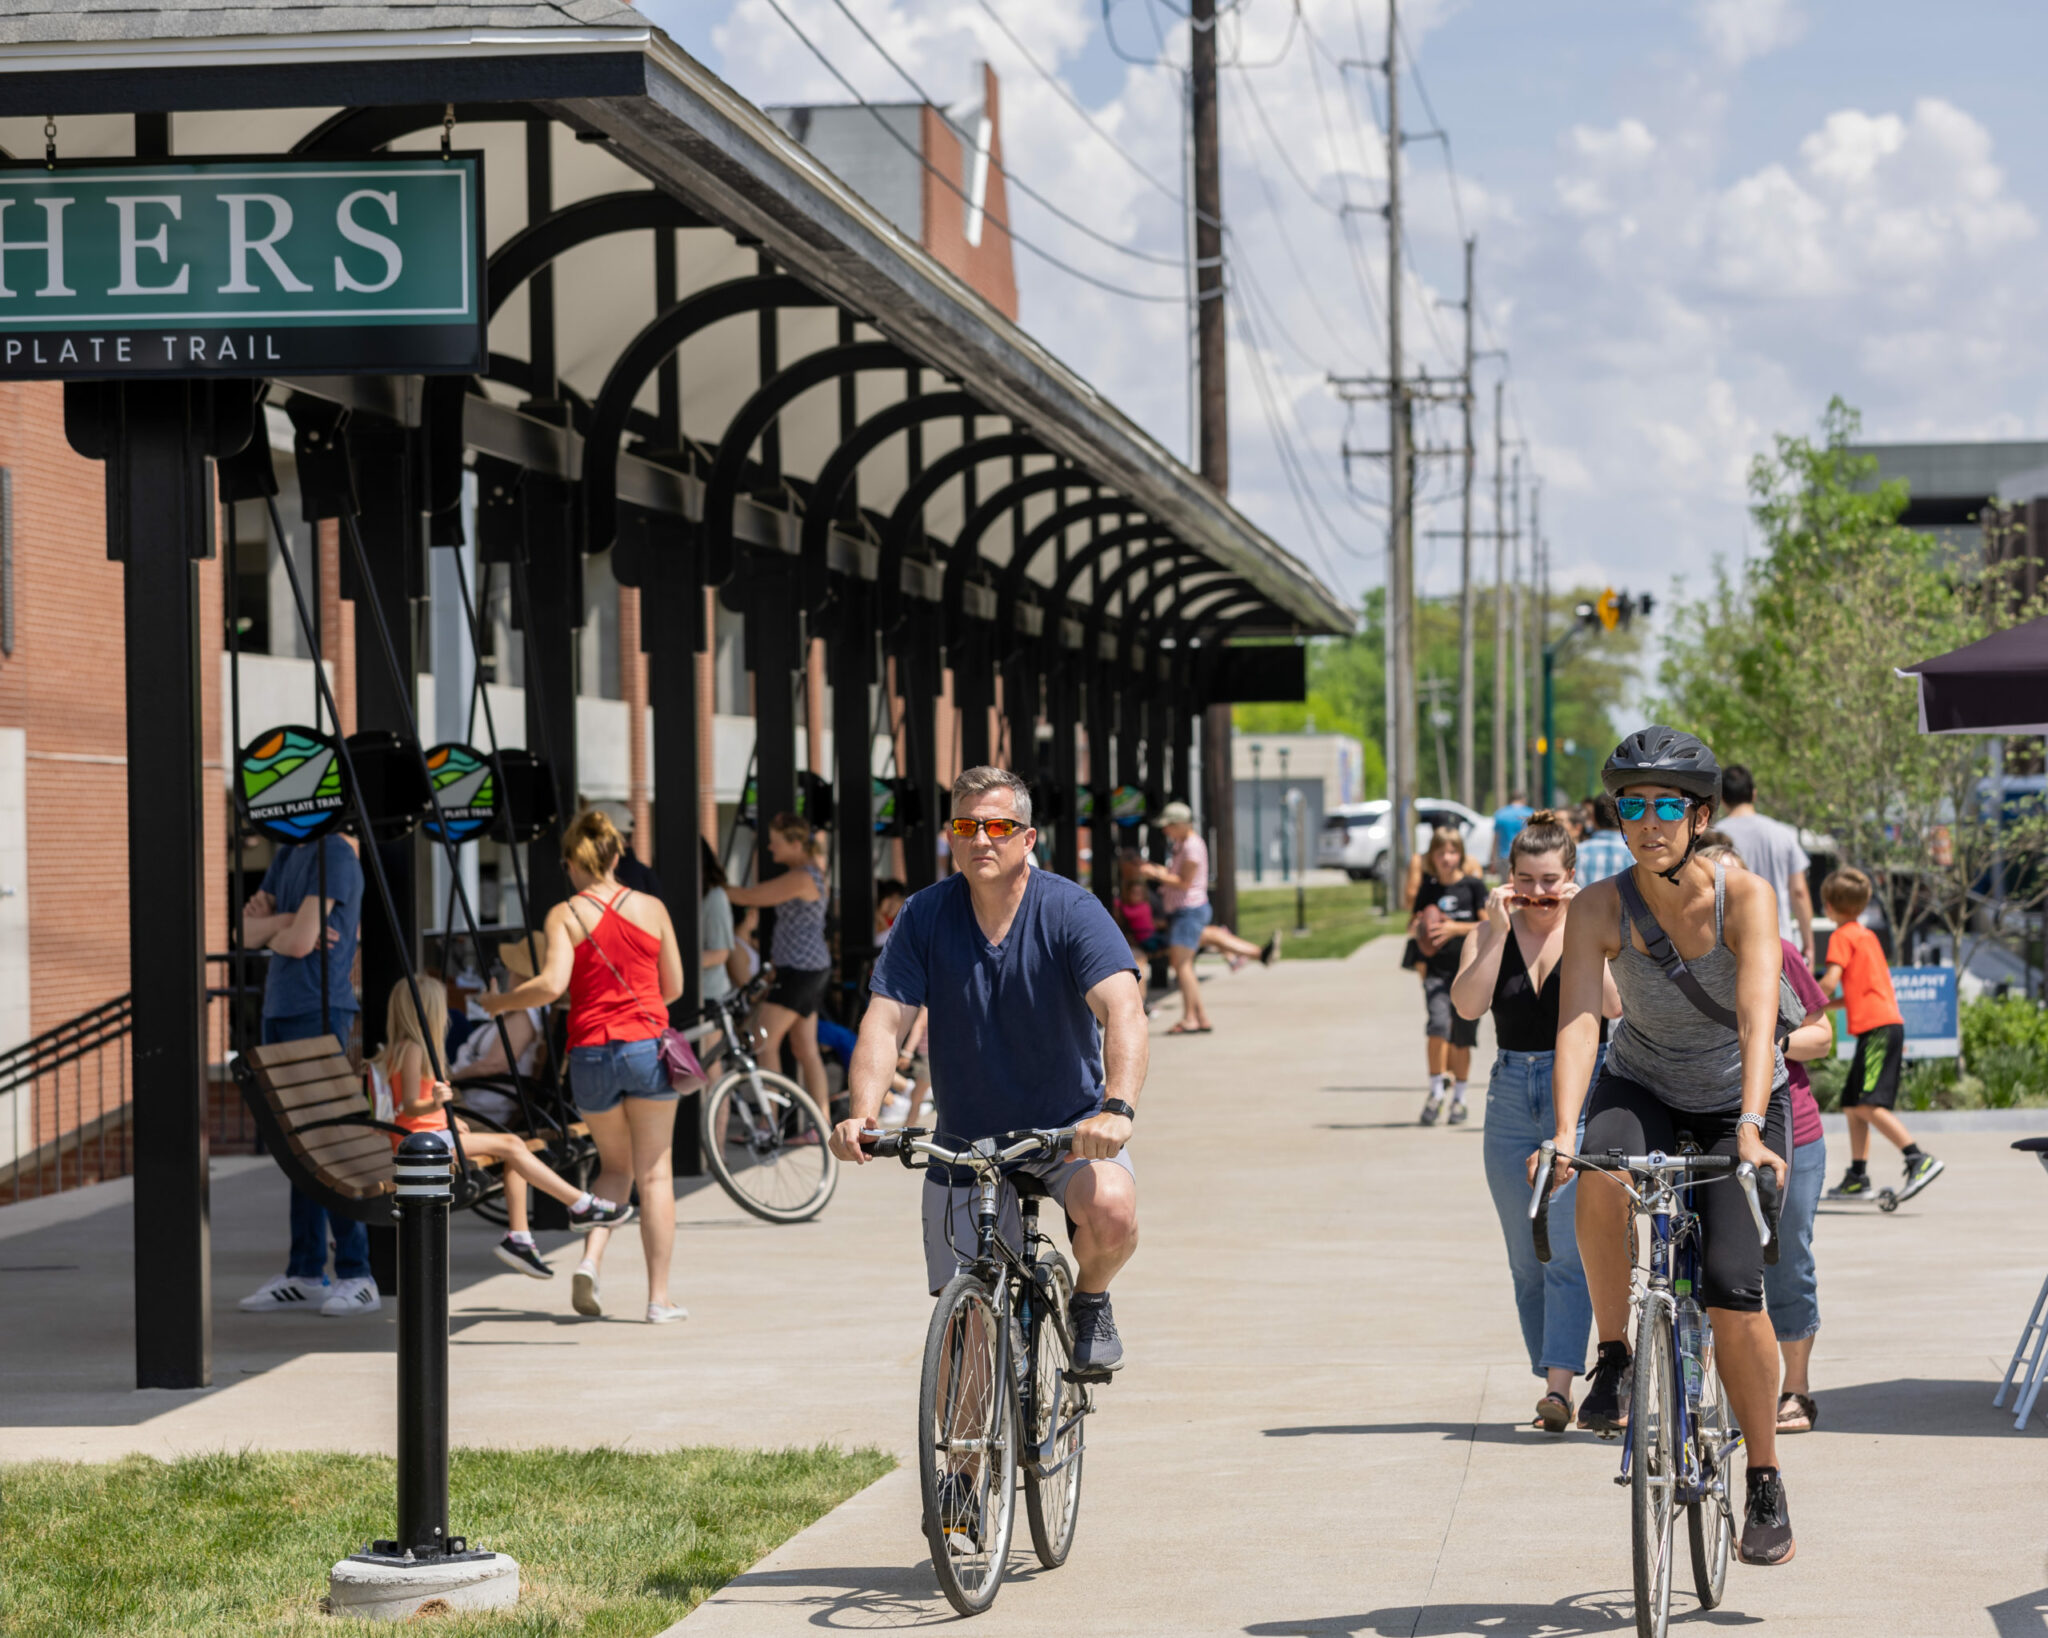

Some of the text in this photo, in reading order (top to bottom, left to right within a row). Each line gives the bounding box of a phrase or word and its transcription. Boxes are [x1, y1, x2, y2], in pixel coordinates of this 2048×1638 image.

[0, 189, 403, 297] HERS
[6, 335, 281, 364] PLATE TRAIL
[249, 796, 343, 820] NICKEL PLATE TRAIL
